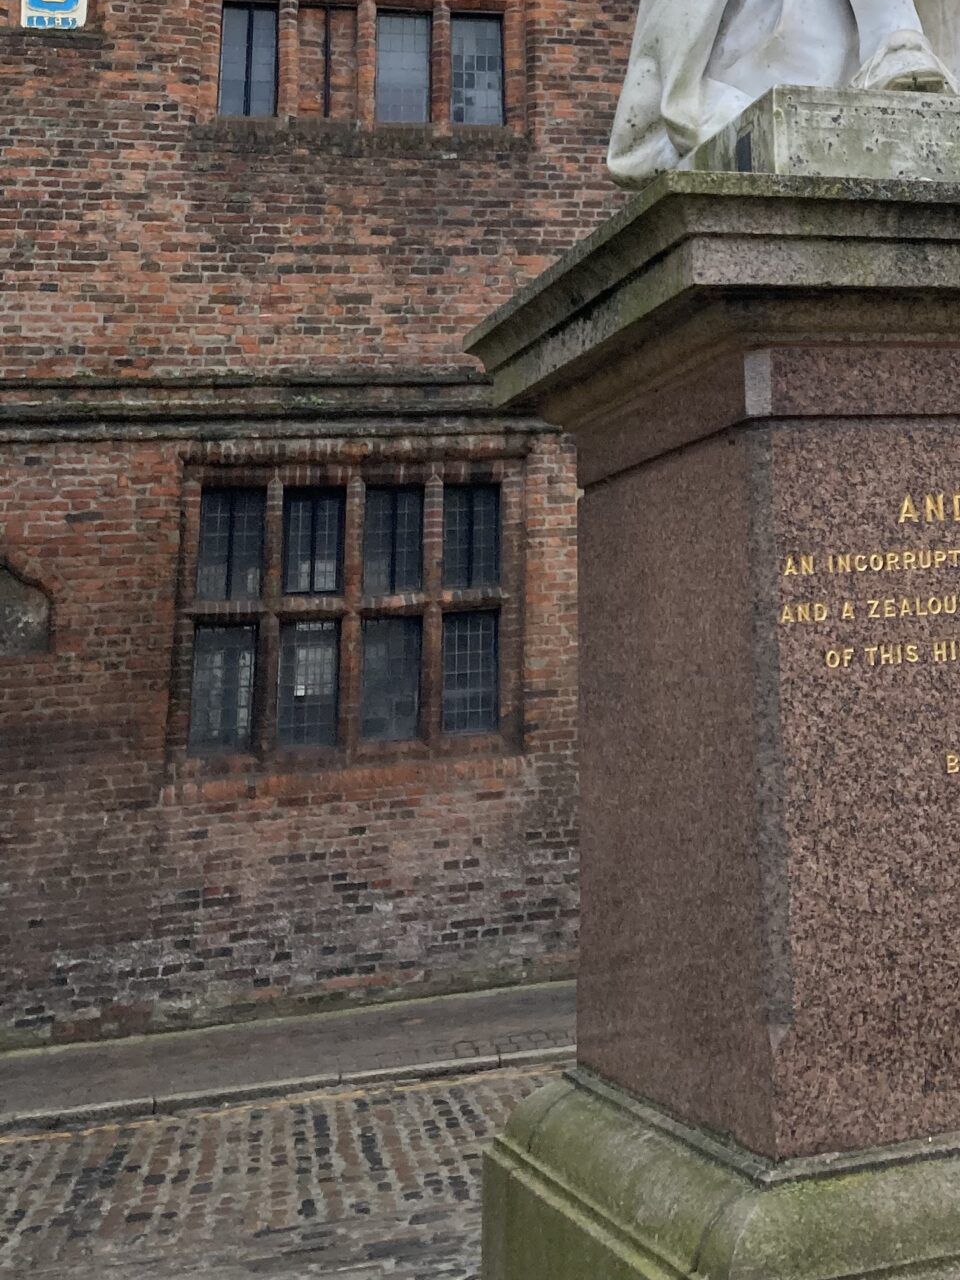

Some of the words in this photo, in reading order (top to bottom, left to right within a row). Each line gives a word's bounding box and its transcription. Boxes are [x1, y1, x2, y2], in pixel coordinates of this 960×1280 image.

[784, 555, 814, 576] AN
[780, 602, 828, 623] AND
[841, 601, 855, 620] A
[825, 647, 854, 669] OF
[864, 643, 919, 665] THIS
